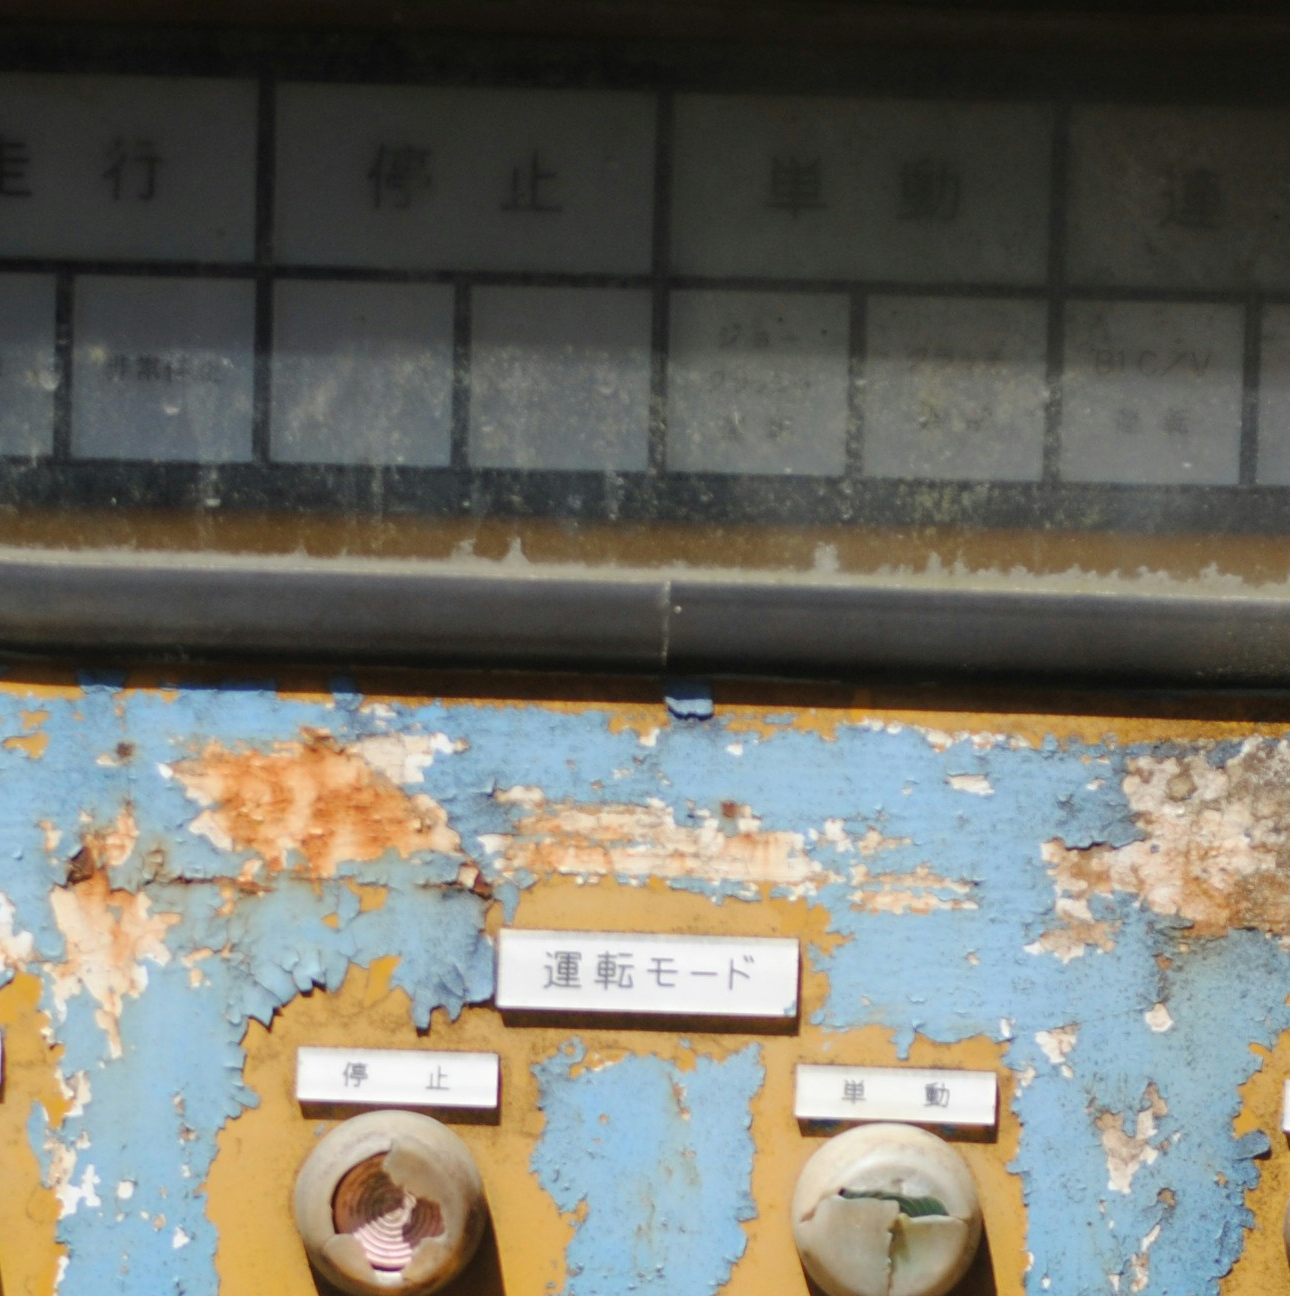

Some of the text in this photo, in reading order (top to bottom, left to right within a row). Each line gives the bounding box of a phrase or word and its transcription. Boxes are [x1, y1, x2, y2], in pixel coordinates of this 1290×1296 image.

[366, 141, 562, 214] 停止
[543, 949, 757, 992] 運転モード
[342, 1060, 451, 1092] 停止
[841, 1079, 951, 1108] 単動
